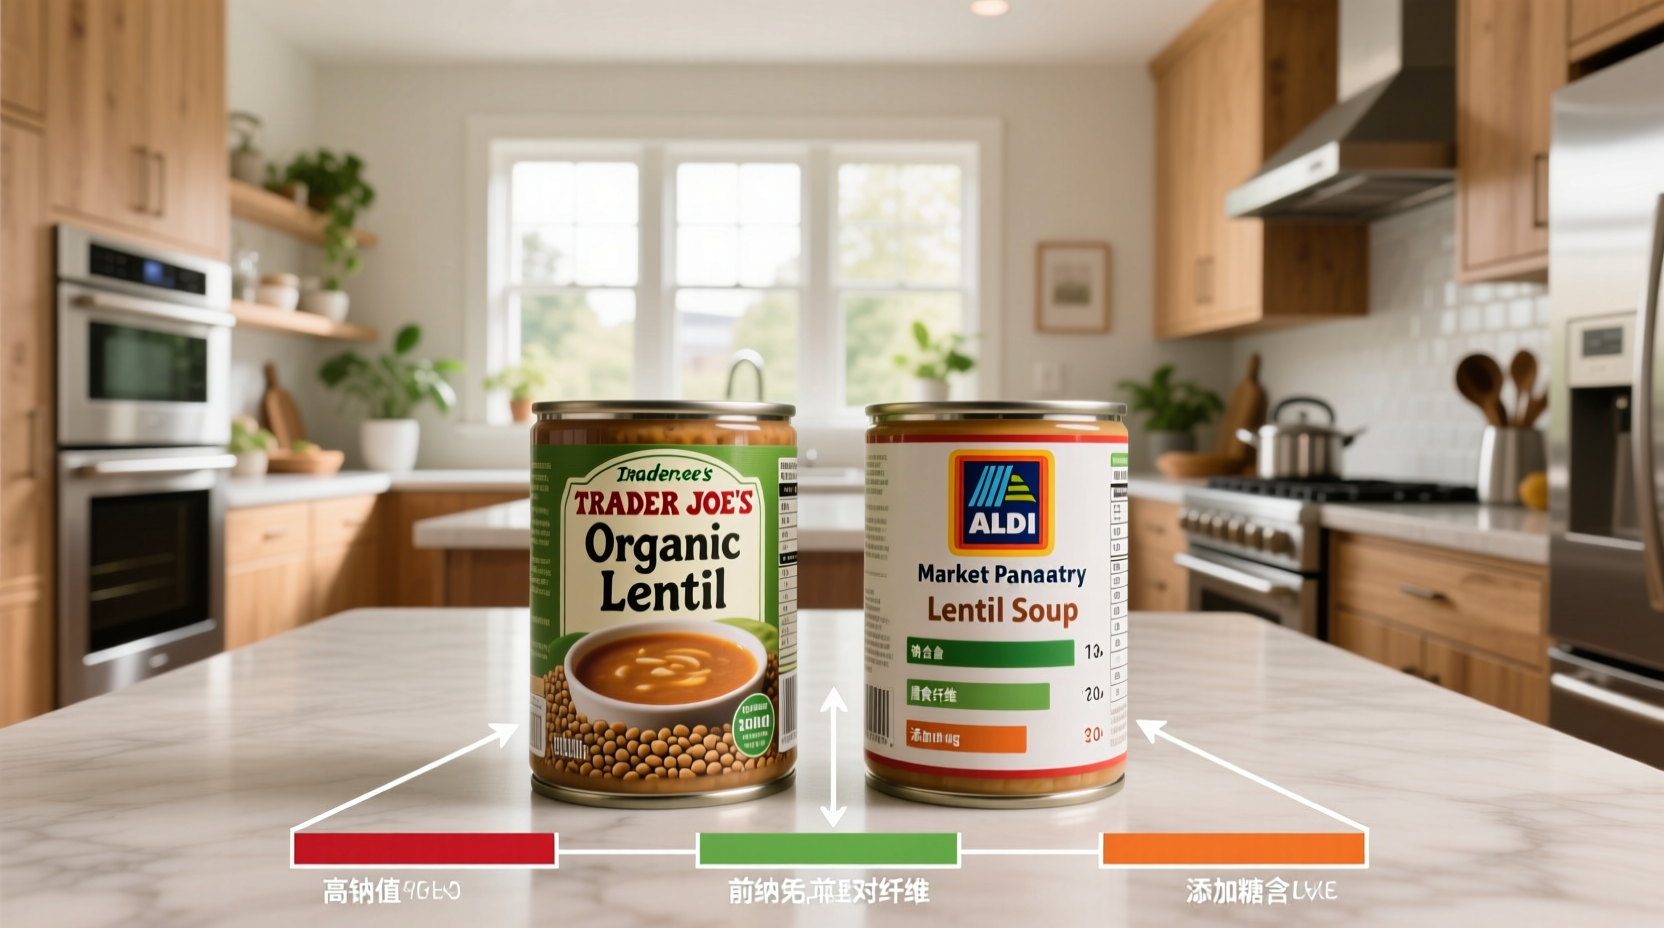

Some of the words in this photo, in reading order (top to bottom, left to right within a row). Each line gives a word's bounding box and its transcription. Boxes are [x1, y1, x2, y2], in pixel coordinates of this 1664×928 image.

[575, 490, 679, 515] TRADER
[686, 489, 753, 515] JOE'S
[968, 512, 1036, 534] ALDI
[585, 522, 741, 574] Organic
[918, 563, 989, 583] Market
[600, 567, 726, 612] Lentil
[928, 596, 1004, 623] Lentil
[1012, 597, 1079, 629] Soup
